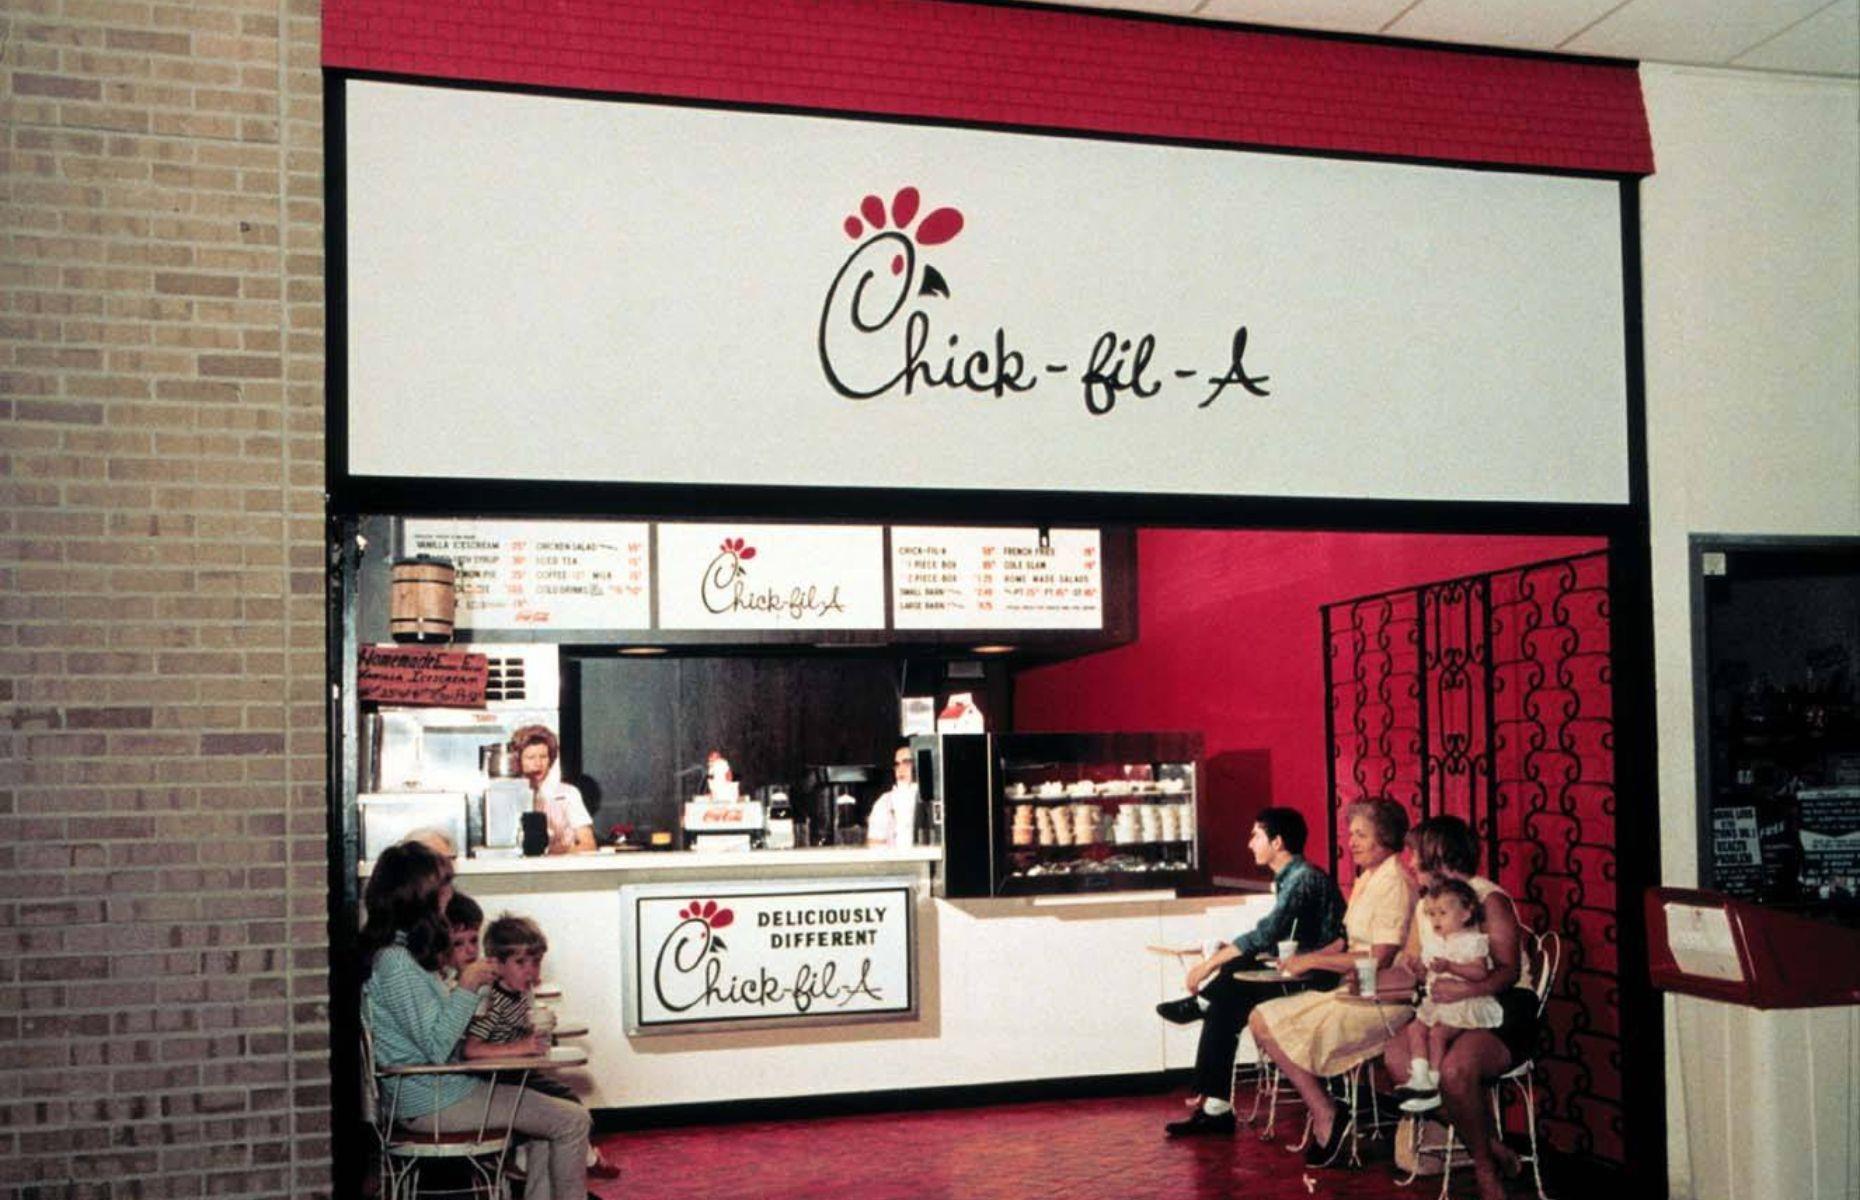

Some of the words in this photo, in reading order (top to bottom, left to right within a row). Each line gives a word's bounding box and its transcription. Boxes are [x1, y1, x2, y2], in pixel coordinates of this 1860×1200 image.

[818, 230, 1270, 416] Chick-fil-A
[757, 908, 887, 927] DELICIOUSLY
[770, 930, 878, 949] DIFFERENT
[654, 918, 883, 1013] Chick-fil-A
